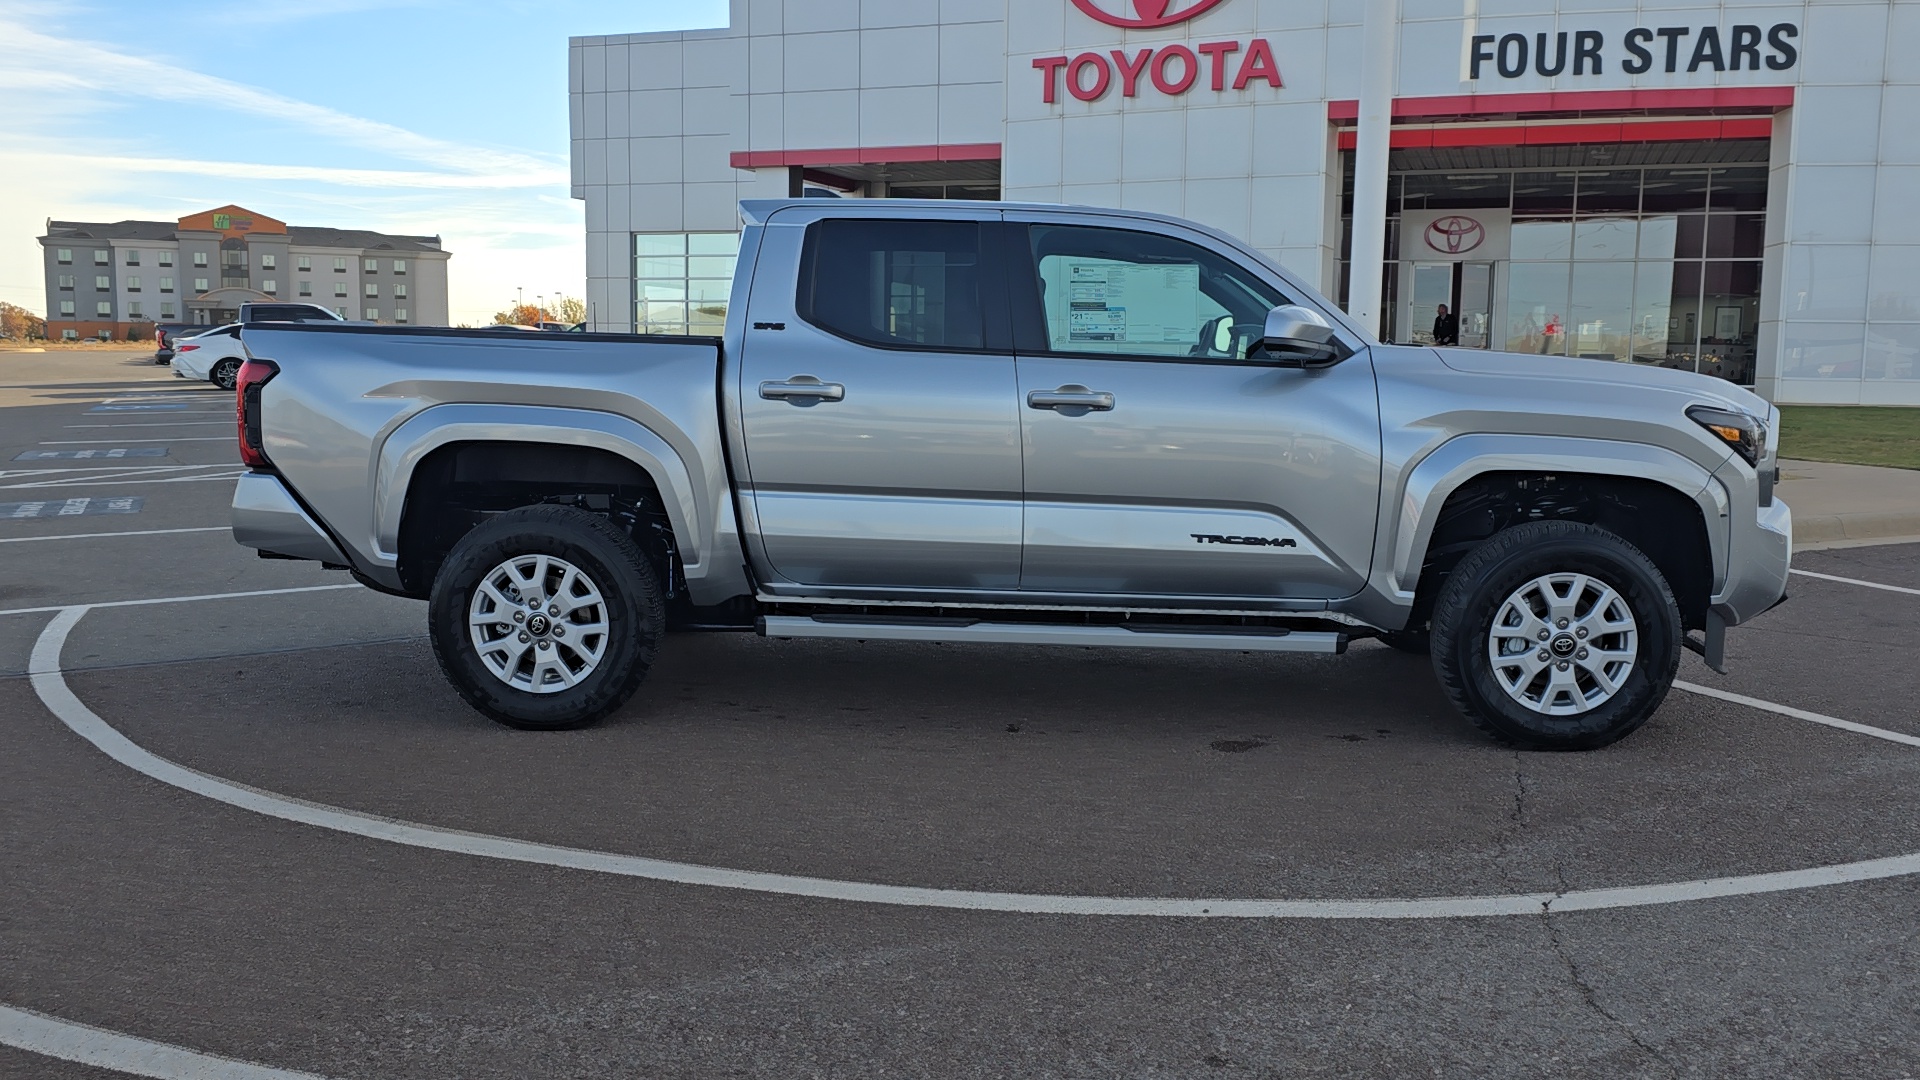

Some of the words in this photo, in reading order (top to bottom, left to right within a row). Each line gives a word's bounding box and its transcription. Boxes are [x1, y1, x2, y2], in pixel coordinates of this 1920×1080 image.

[1032, 38, 1283, 103] TOYOTA
[1469, 30, 1604, 80] FOUR
[1622, 23, 1799, 75] STARS
[1190, 533, 1297, 548] TACOMA
